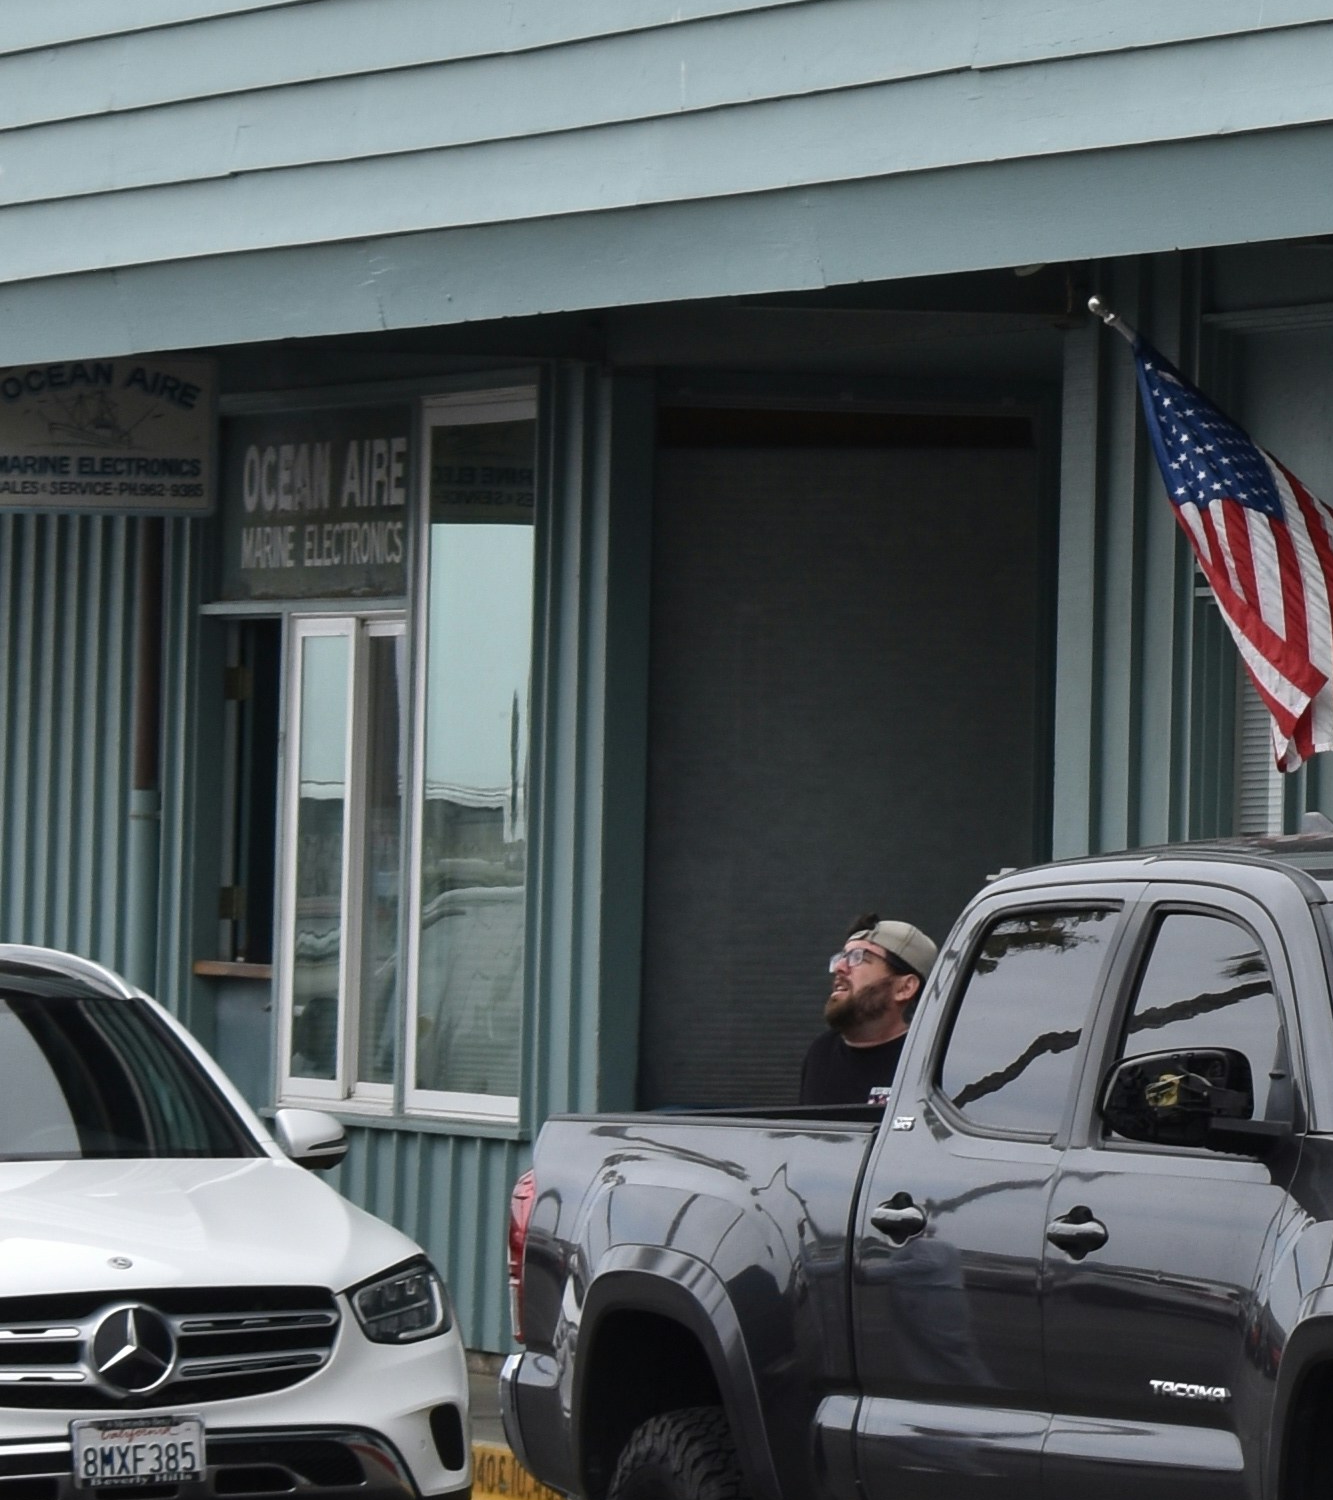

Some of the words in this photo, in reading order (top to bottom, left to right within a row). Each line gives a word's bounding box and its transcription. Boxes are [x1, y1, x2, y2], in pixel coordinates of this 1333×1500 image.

[1, 362, 113, 399] OCEAN
[125, 367, 202, 410] AIRE
[77, 456, 202, 478] ELECTRONICS
[242, 442, 331, 513] OCEAN
[341, 437, 407, 508] AIRE
[240, 525, 295, 569] MARINE
[303, 521, 404, 567] ELECTRONICS
[1149, 1379, 1227, 1401] TACOMA
[83, 1441, 196, 1477] 8MXF385
